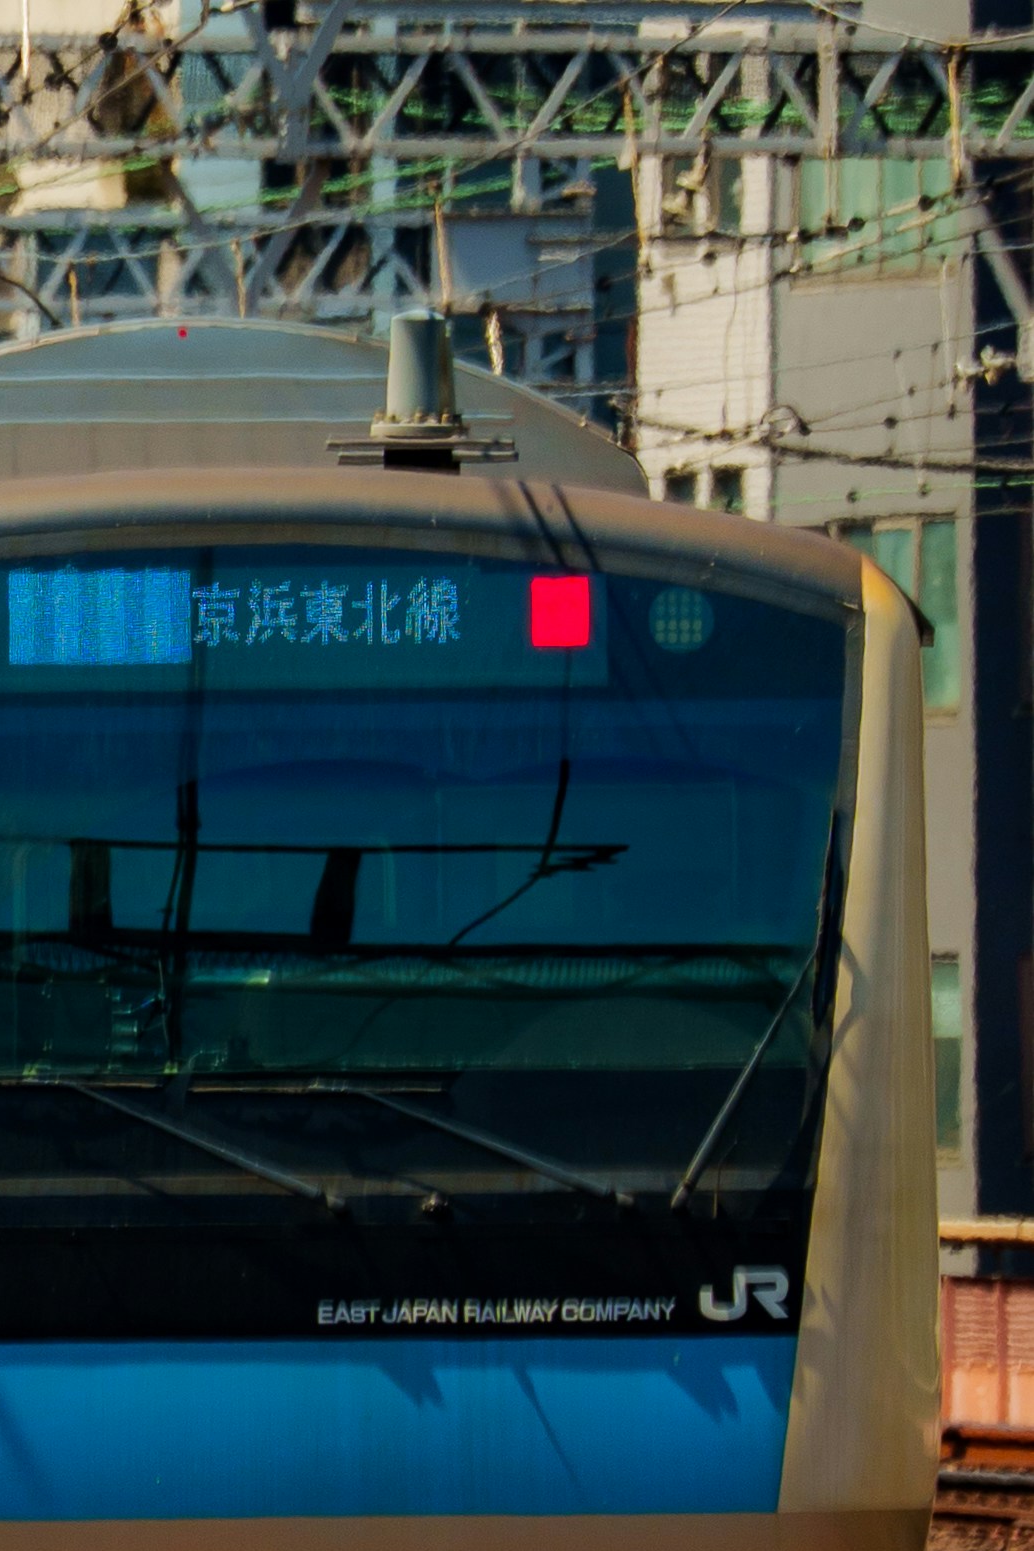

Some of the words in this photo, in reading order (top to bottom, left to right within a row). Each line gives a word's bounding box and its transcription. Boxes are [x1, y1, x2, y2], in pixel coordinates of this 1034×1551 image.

[192, 575, 461, 647] 京浜東北線
[317, 1299, 380, 1324] EAST
[382, 1298, 459, 1323] JAPAN
[464, 1298, 559, 1323] RAILWAY
[561, 1297, 676, 1322] COMPANY
[699, 1265, 789, 1321] JR
